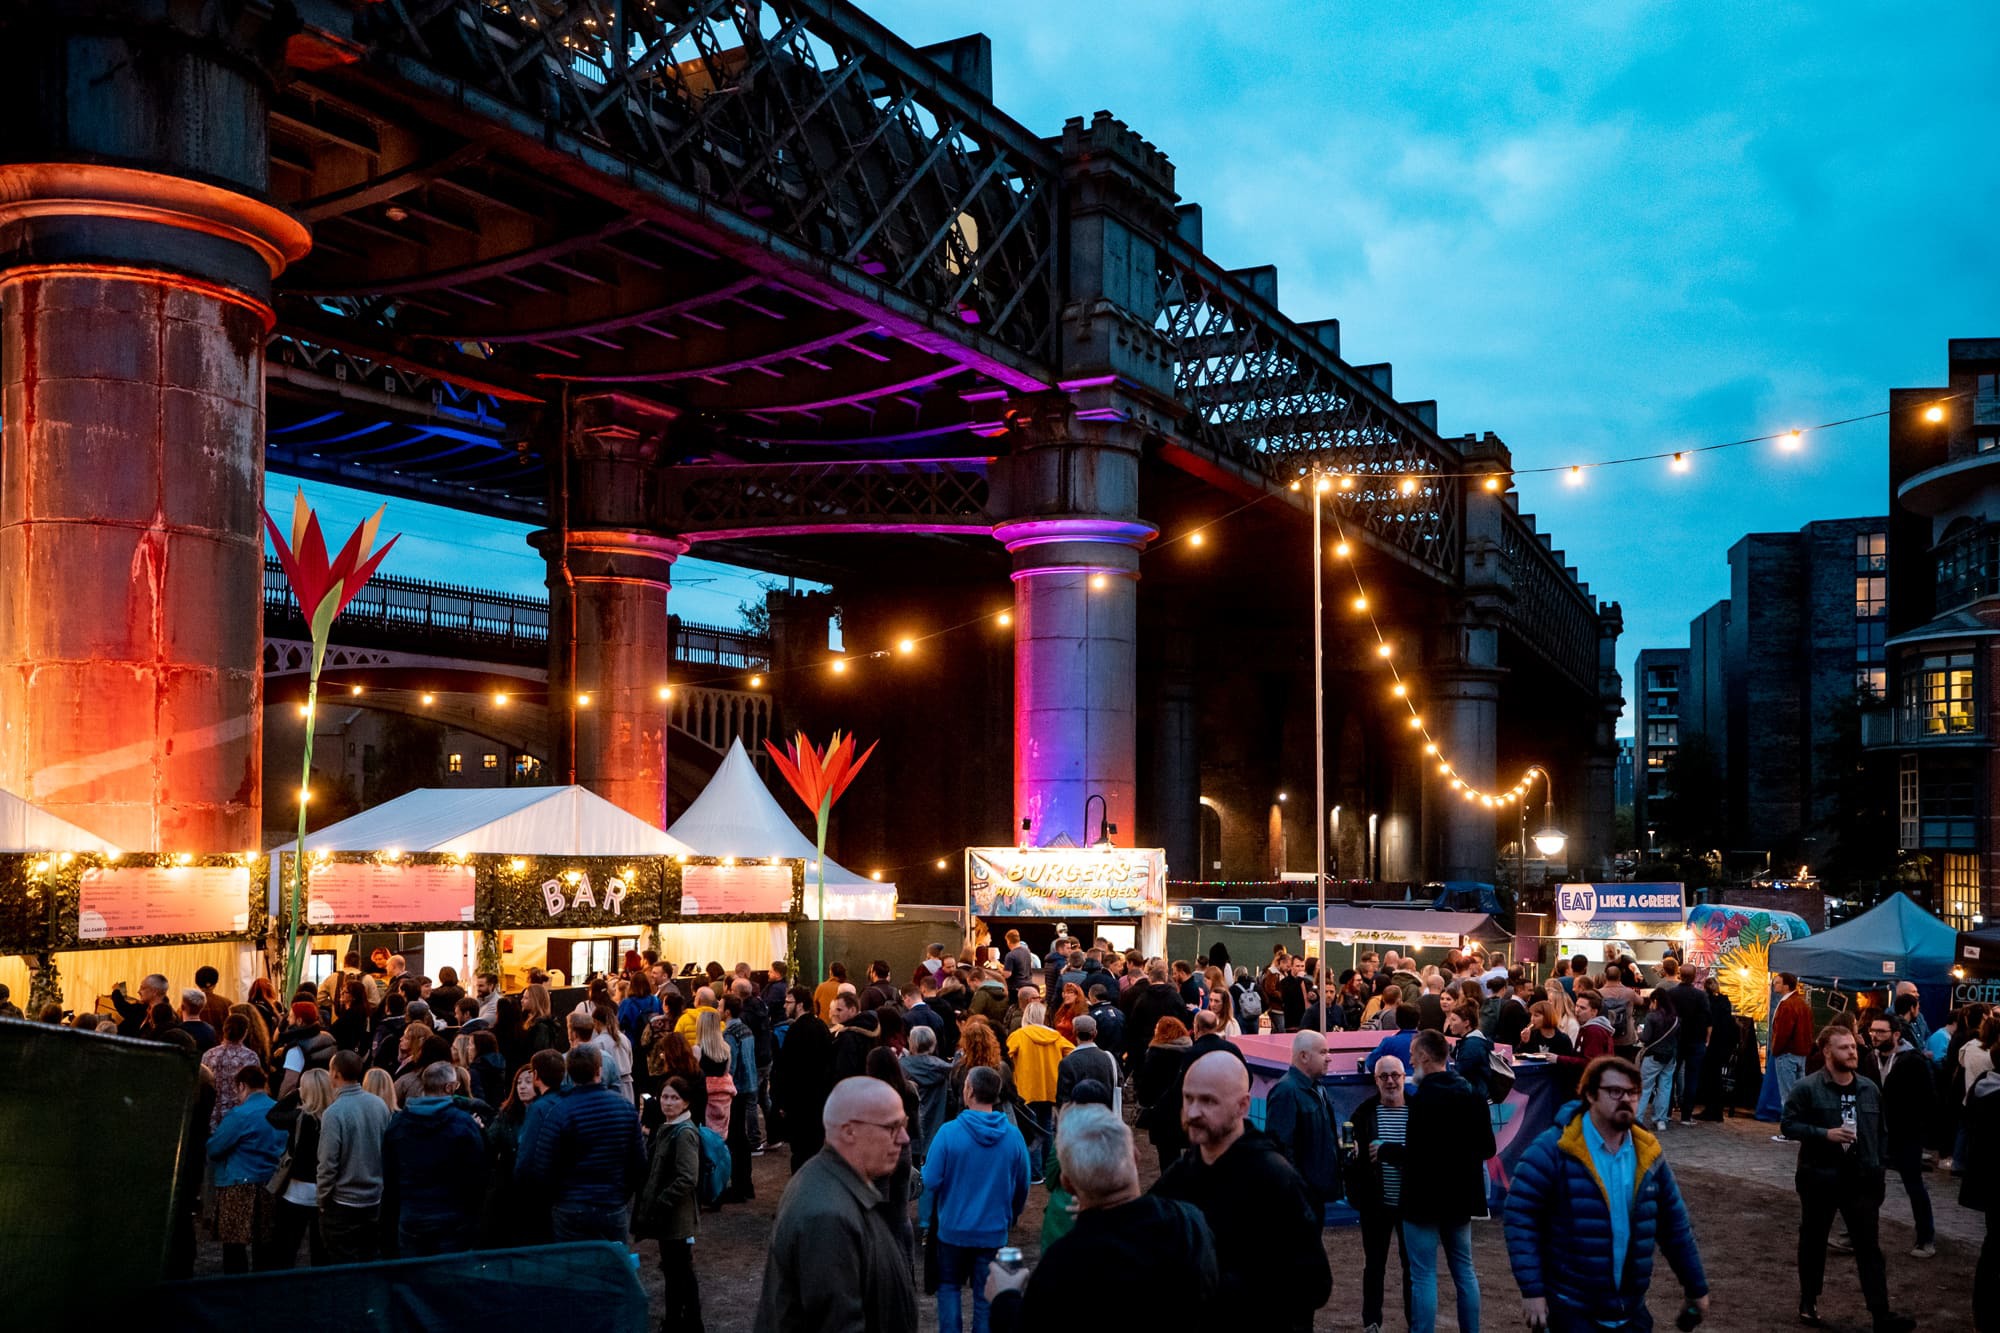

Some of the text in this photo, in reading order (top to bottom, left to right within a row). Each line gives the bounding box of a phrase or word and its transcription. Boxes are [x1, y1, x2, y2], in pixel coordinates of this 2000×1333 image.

[1008, 863, 1130, 882] BURGERS
[541, 872, 627, 917] BAR
[995, 886, 1139, 899] HOT SALT BEEF BAGELS
[1562, 892, 1680, 910] EAT LIKE A GREEK
